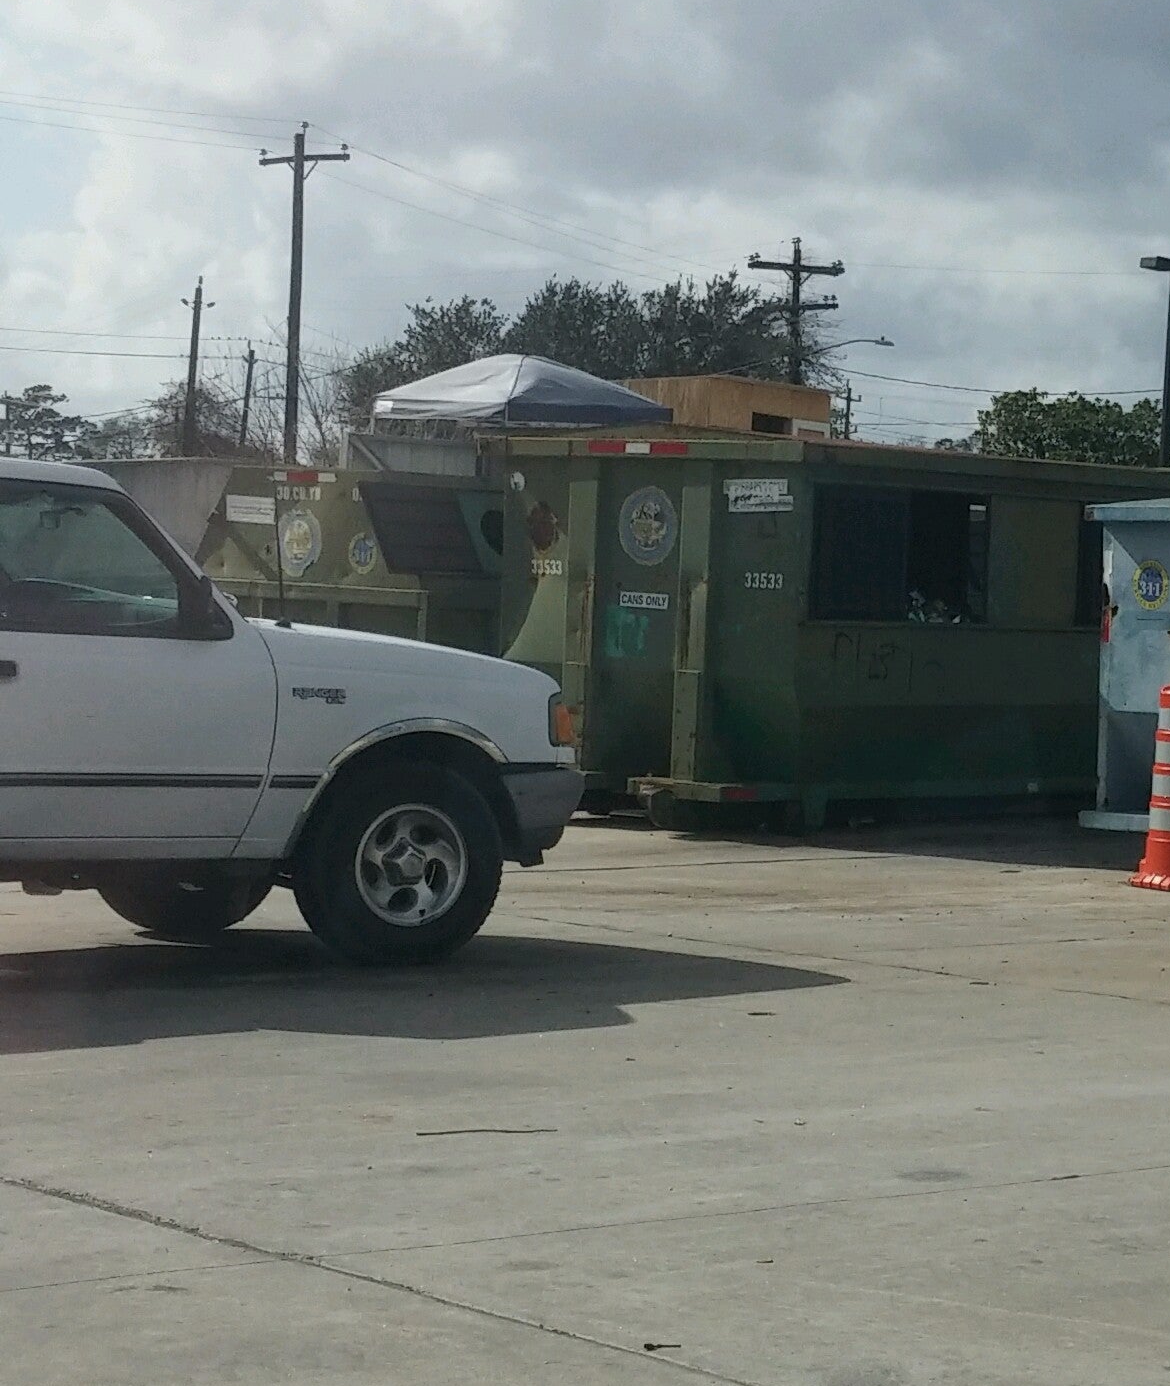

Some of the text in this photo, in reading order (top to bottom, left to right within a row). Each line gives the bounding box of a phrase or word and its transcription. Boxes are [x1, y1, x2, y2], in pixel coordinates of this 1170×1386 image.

[531, 560, 562, 574] 33533
[744, 572, 784, 589] 33533
[621, 594, 667, 607] CANS ONLY
